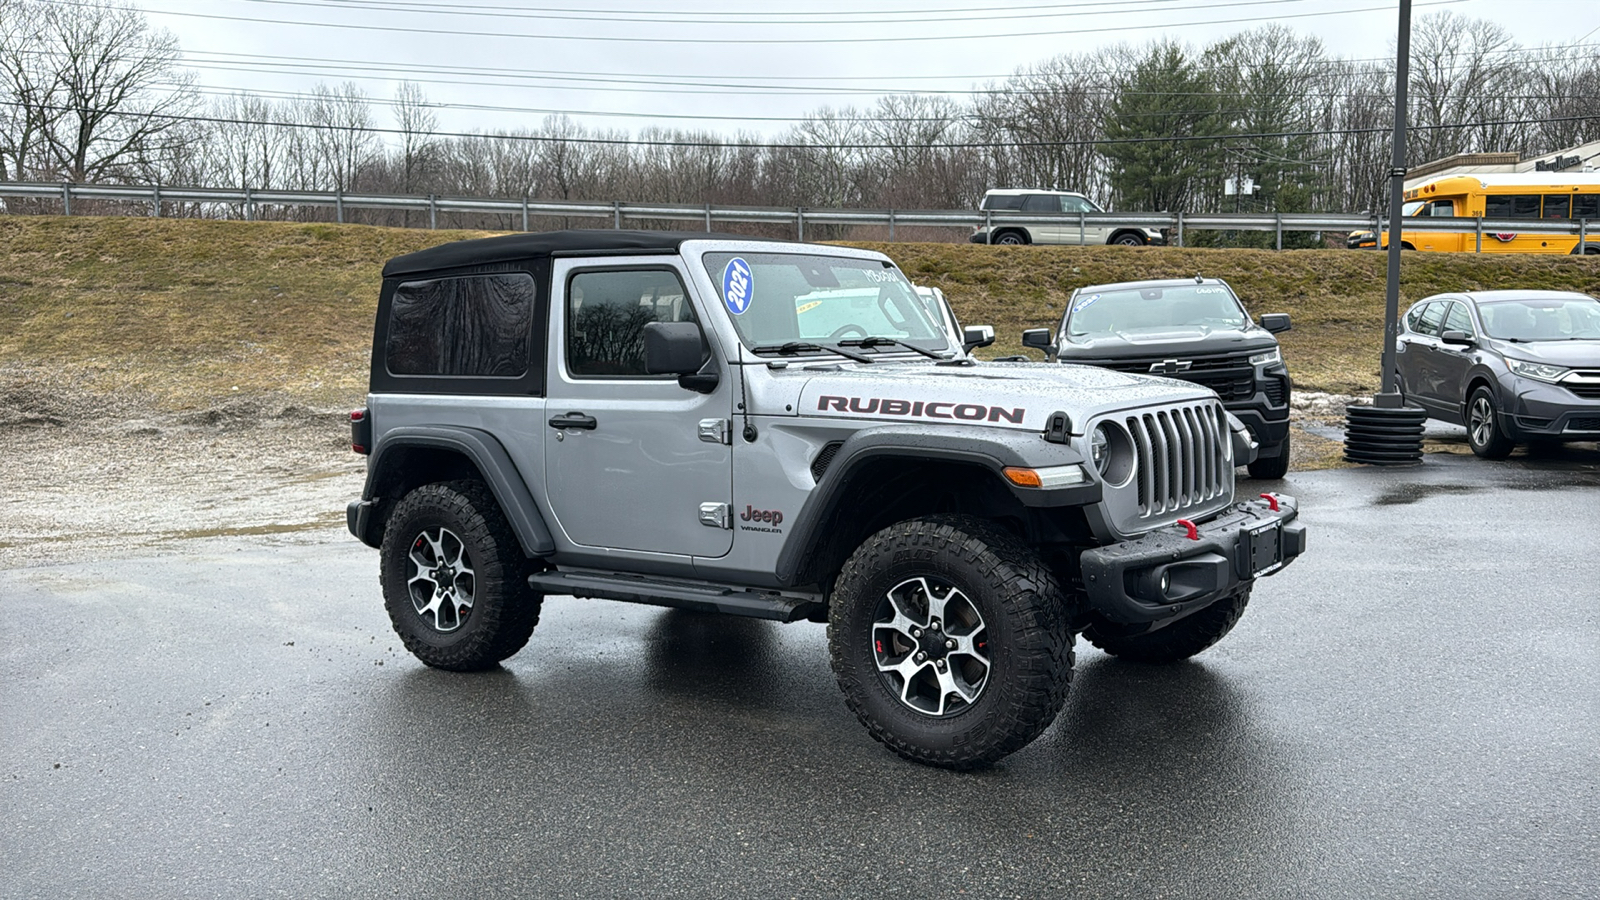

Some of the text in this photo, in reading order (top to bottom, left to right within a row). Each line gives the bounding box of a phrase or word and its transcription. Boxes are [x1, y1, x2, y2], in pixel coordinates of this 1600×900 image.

[727, 260, 750, 311] 2021
[817, 395, 1026, 425] RUBICON
[740, 504, 784, 527] Jeep
[740, 525, 783, 534] WRANGLER
